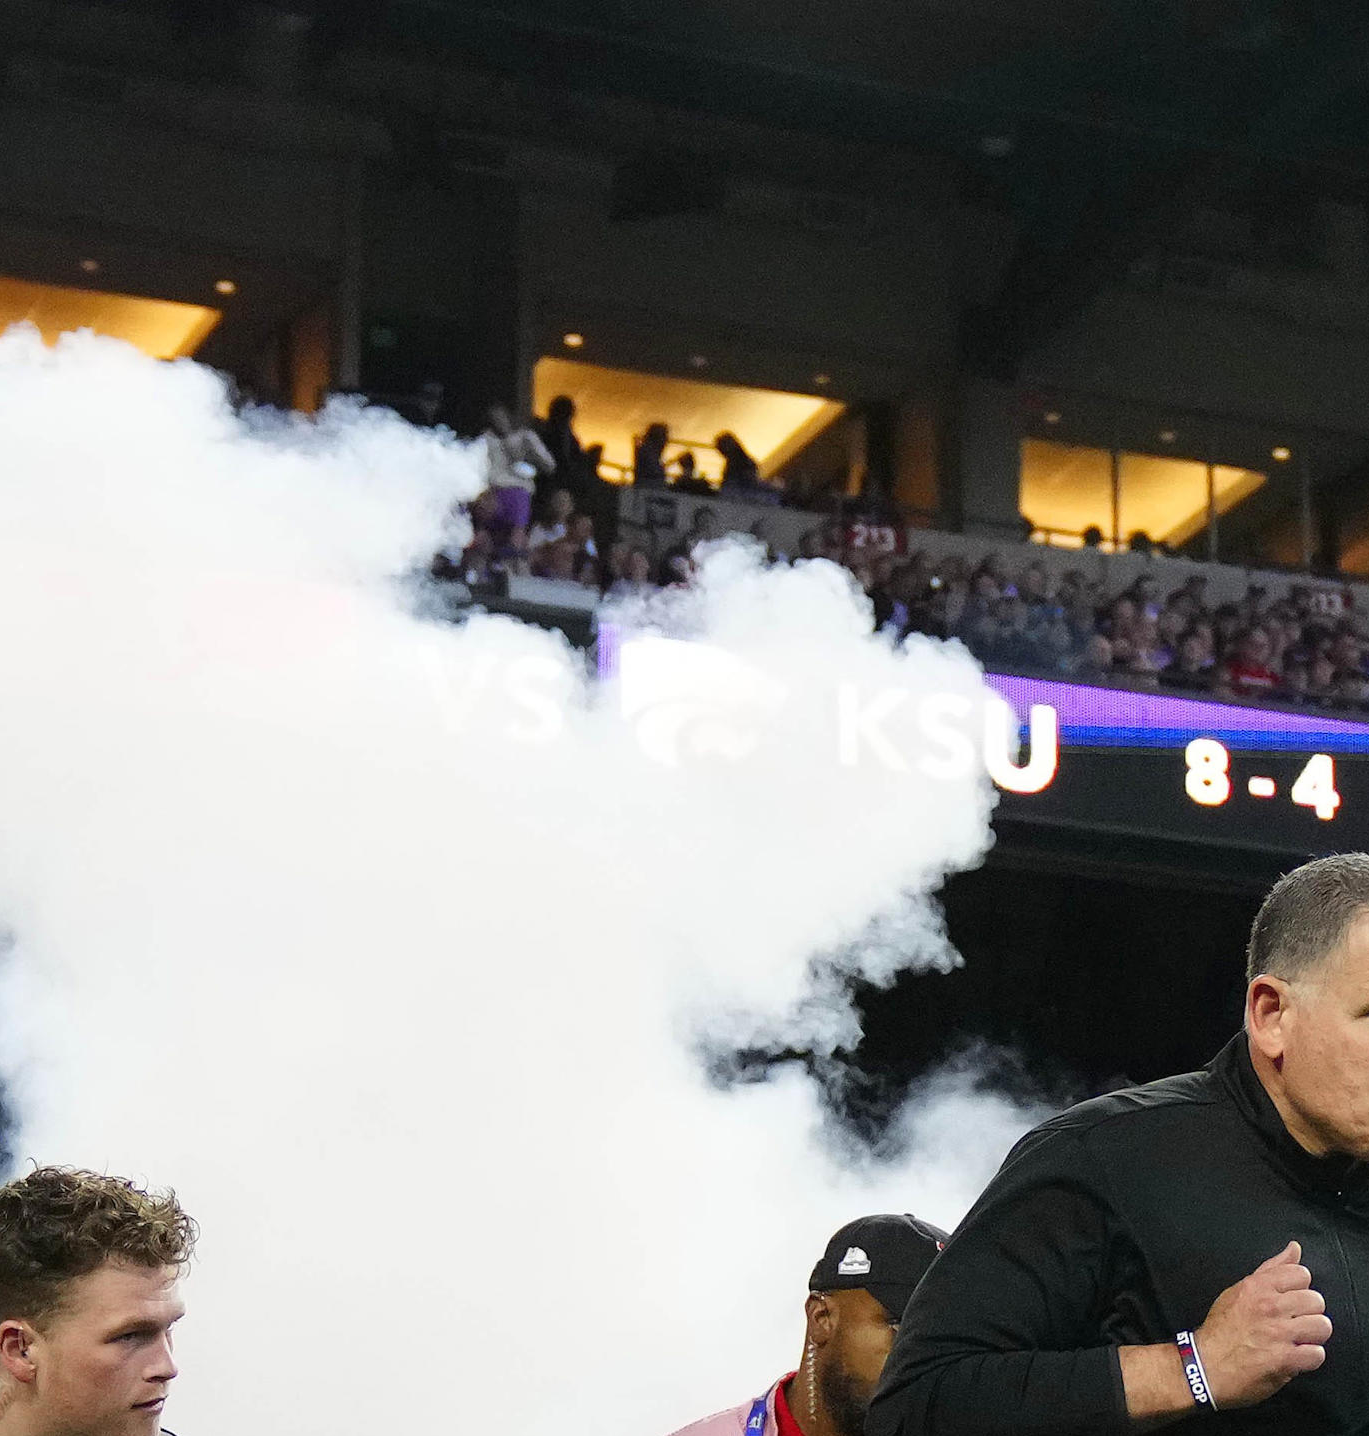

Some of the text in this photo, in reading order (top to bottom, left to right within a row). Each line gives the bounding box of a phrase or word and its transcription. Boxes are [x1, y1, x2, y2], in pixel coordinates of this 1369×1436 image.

[416, 643, 562, 750] VS
[835, 680, 1060, 793] KSU
[1185, 1363, 1208, 1403] CHOP
